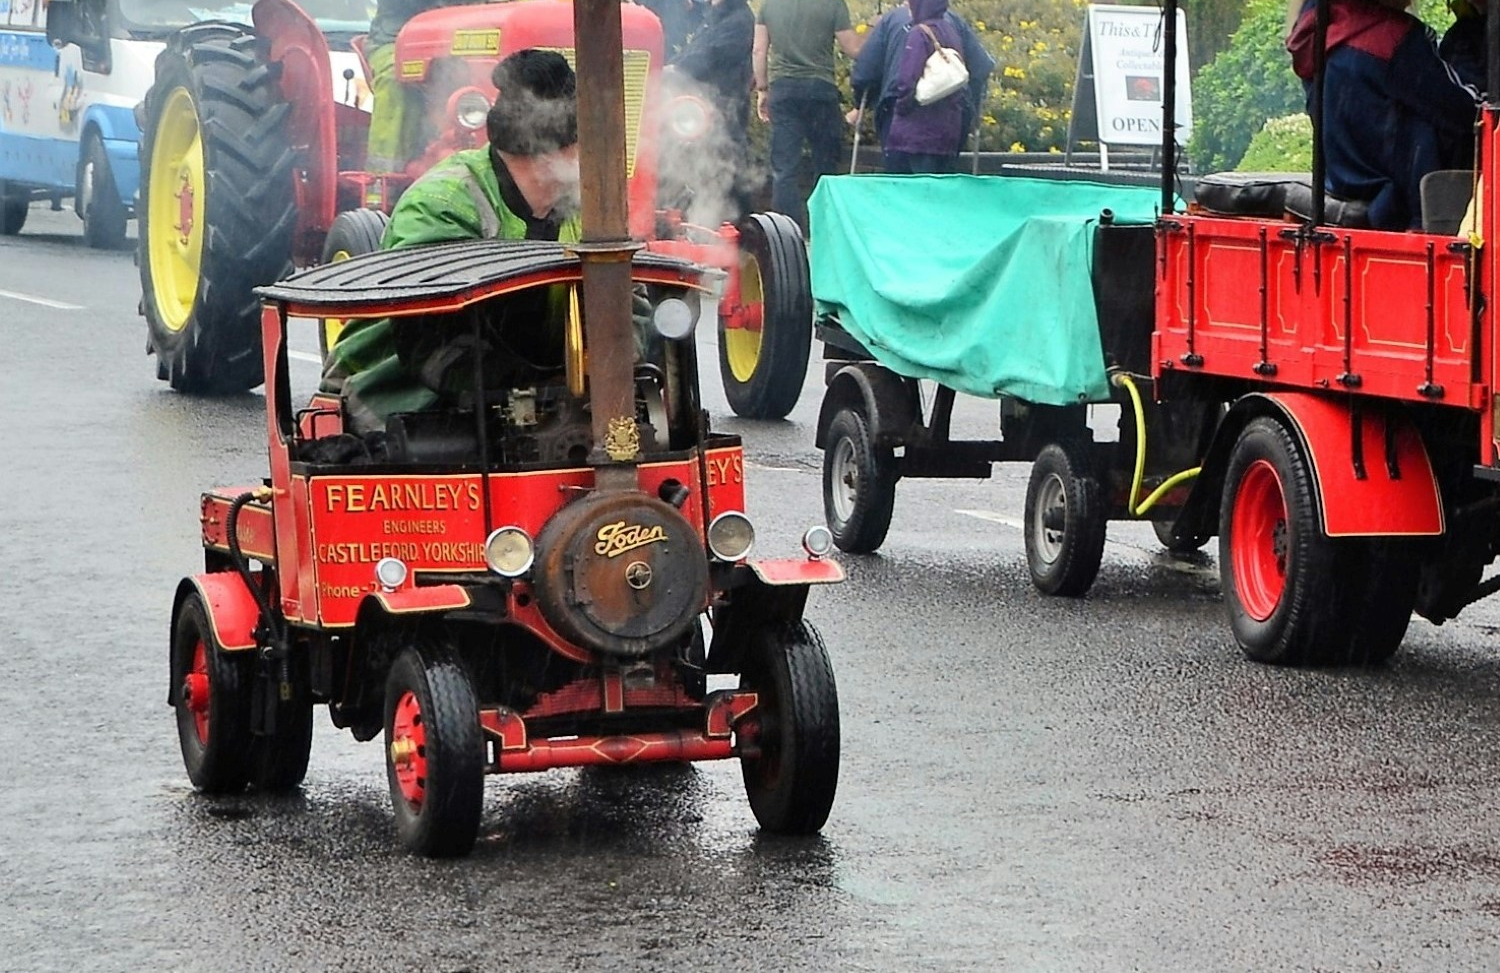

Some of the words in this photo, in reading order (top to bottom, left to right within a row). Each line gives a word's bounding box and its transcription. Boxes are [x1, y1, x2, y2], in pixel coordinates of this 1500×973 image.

[1112, 117, 1160, 133] OPEN
[326, 480, 481, 512] FEARNLEY'S
[383, 519, 447, 535] ENGINEERS
[594, 520, 670, 558] Foden
[423, 542, 488, 563] YORKSHIR
